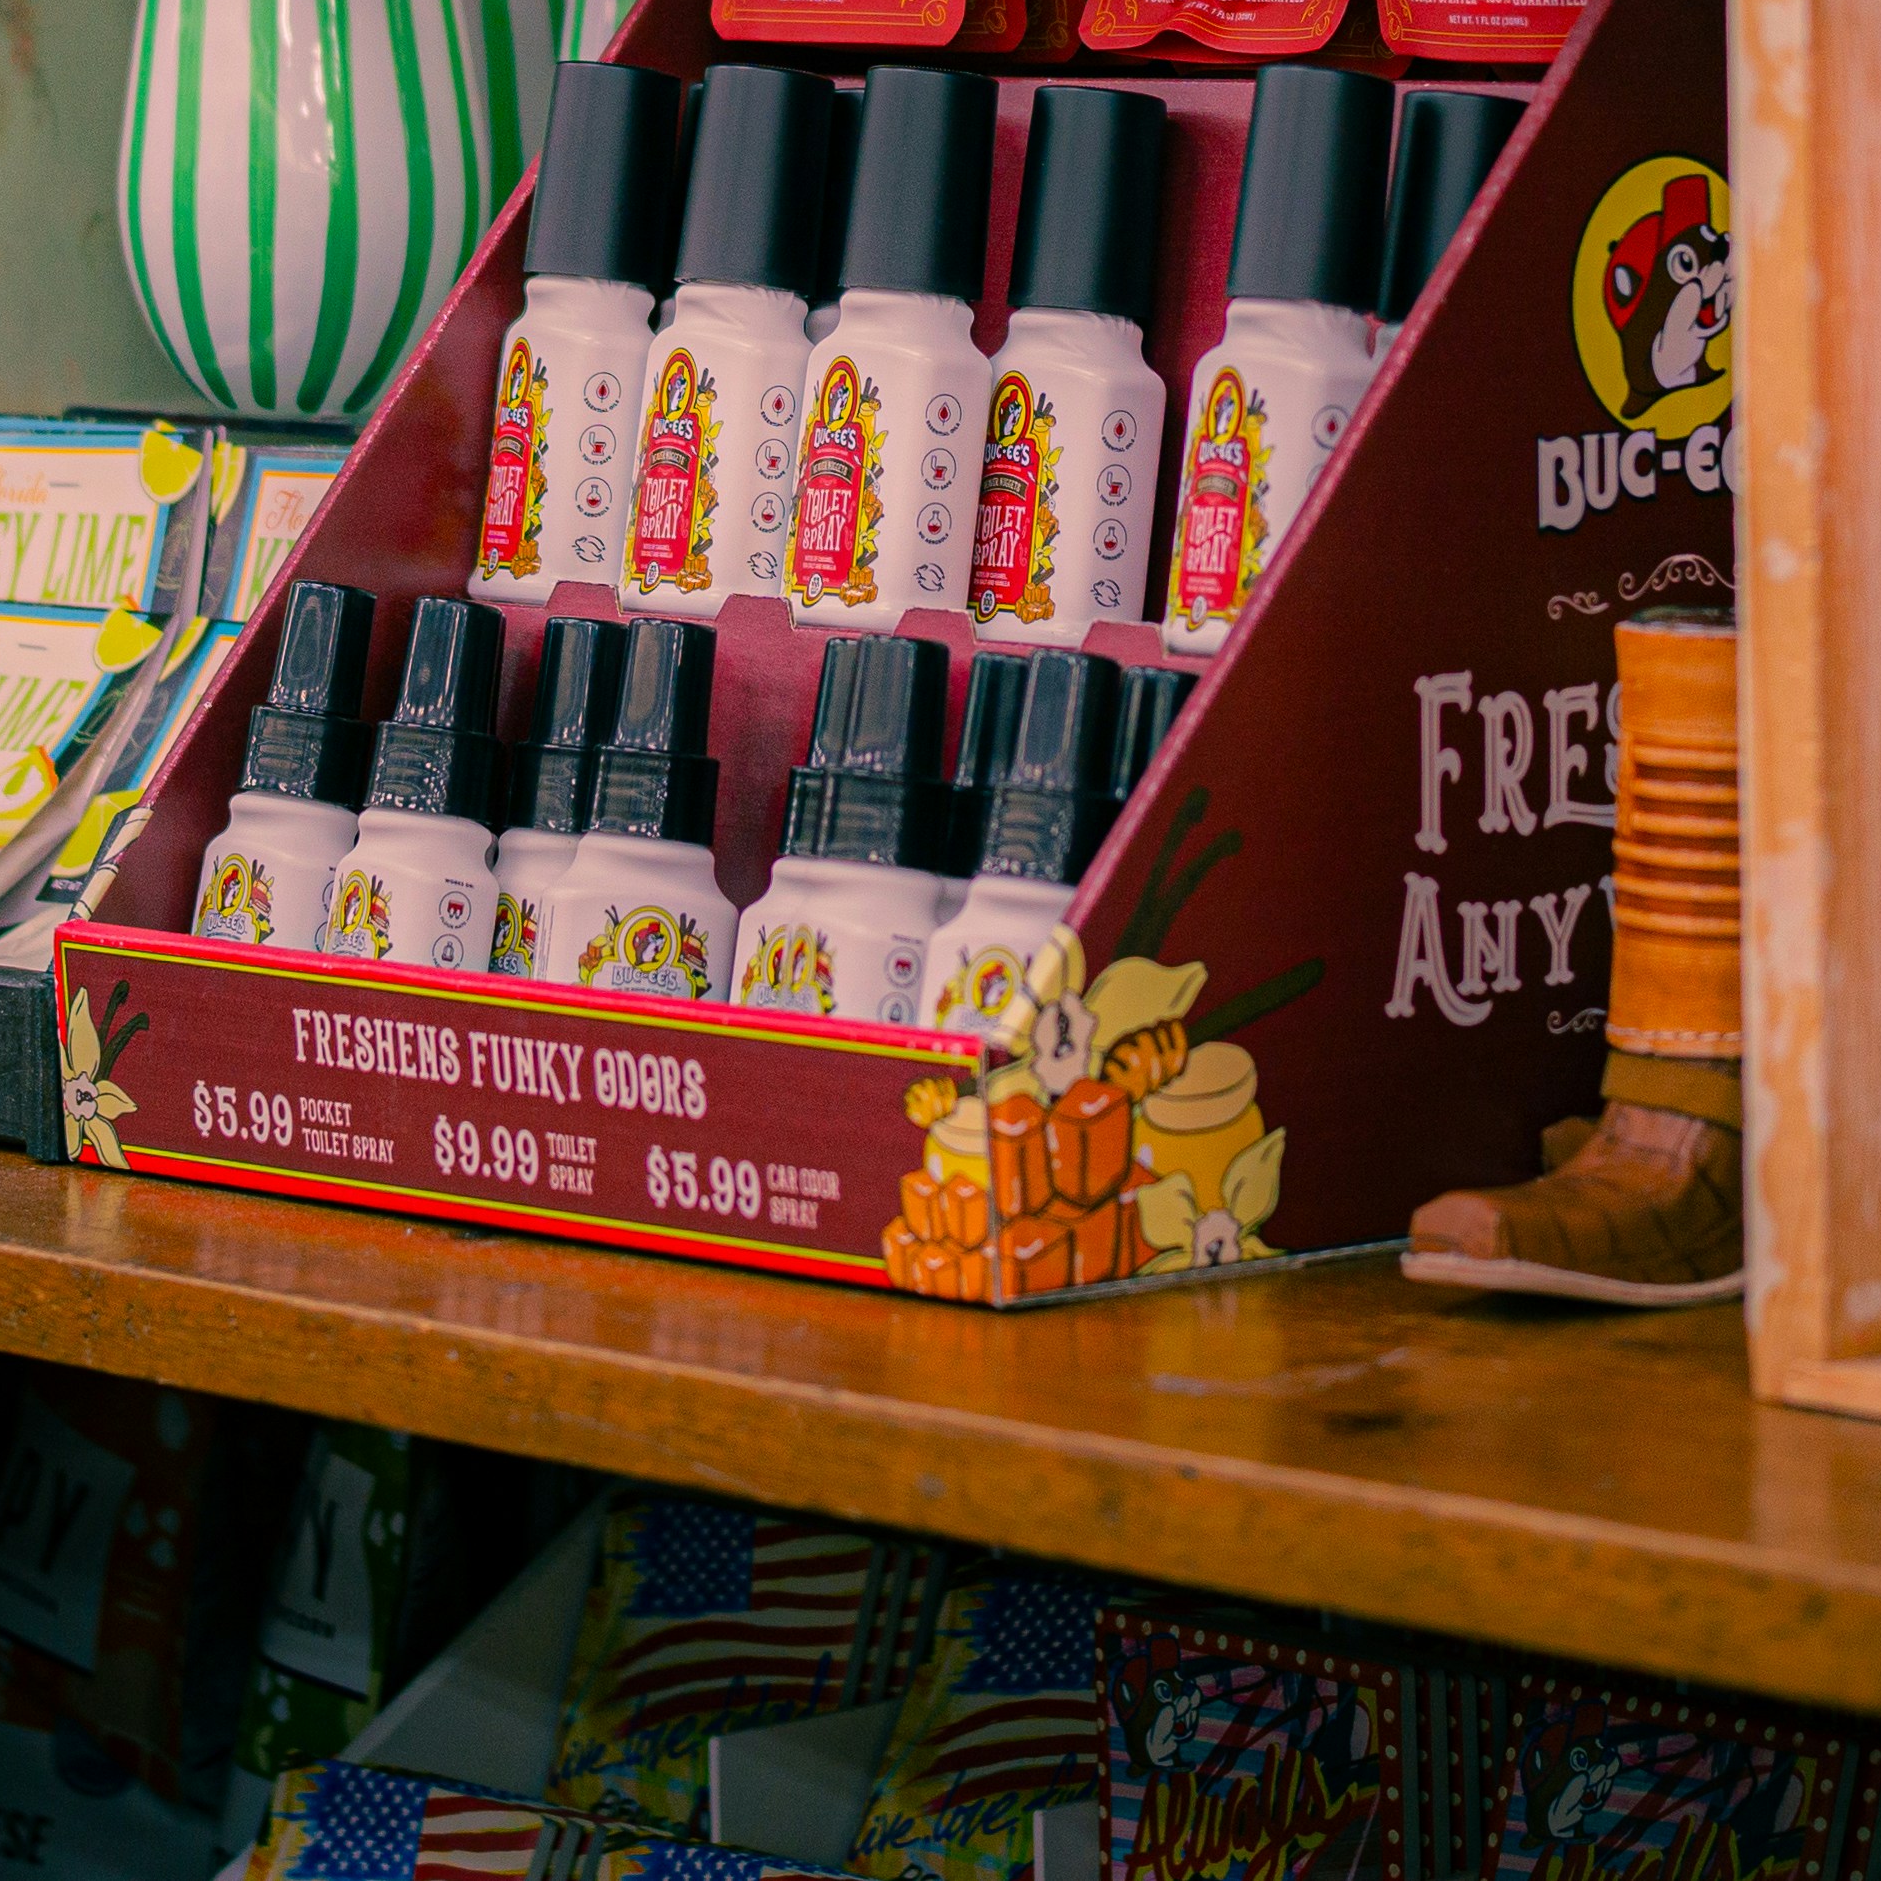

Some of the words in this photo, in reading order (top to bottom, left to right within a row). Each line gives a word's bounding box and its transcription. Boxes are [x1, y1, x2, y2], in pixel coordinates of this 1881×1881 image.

[646, 478, 688, 514] TOILET
[806, 489, 852, 525] TOILET
[641, 503, 682, 539] SPRAY
[802, 514, 846, 551] SPRAY
[976, 504, 1026, 542] TOILET
[37, 512, 148, 605] LIME
[973, 530, 1019, 568] SPRAY
[612, 965, 680, 992] BUC-EE'S
[293, 1008, 462, 1086] FRESHENS
[468, 1031, 585, 1105] FUNKY
[593, 1047, 709, 1120] ODORS
[190, 1078, 295, 1148] $5.99
[299, 1096, 352, 1128] POCKET
[301, 1126, 350, 1159] TOILET
[351, 1134, 395, 1165] SPRAY
[433, 1113, 541, 1186] $9.99
[545, 1131, 598, 1166] TOILET
[548, 1164, 594, 1196] SPRAY
[646, 1143, 762, 1219] $5.99
[766, 1162, 799, 1195] CAR
[798, 1167, 841, 1202] ODOR
[769, 1195, 819, 1230] SPRAY
